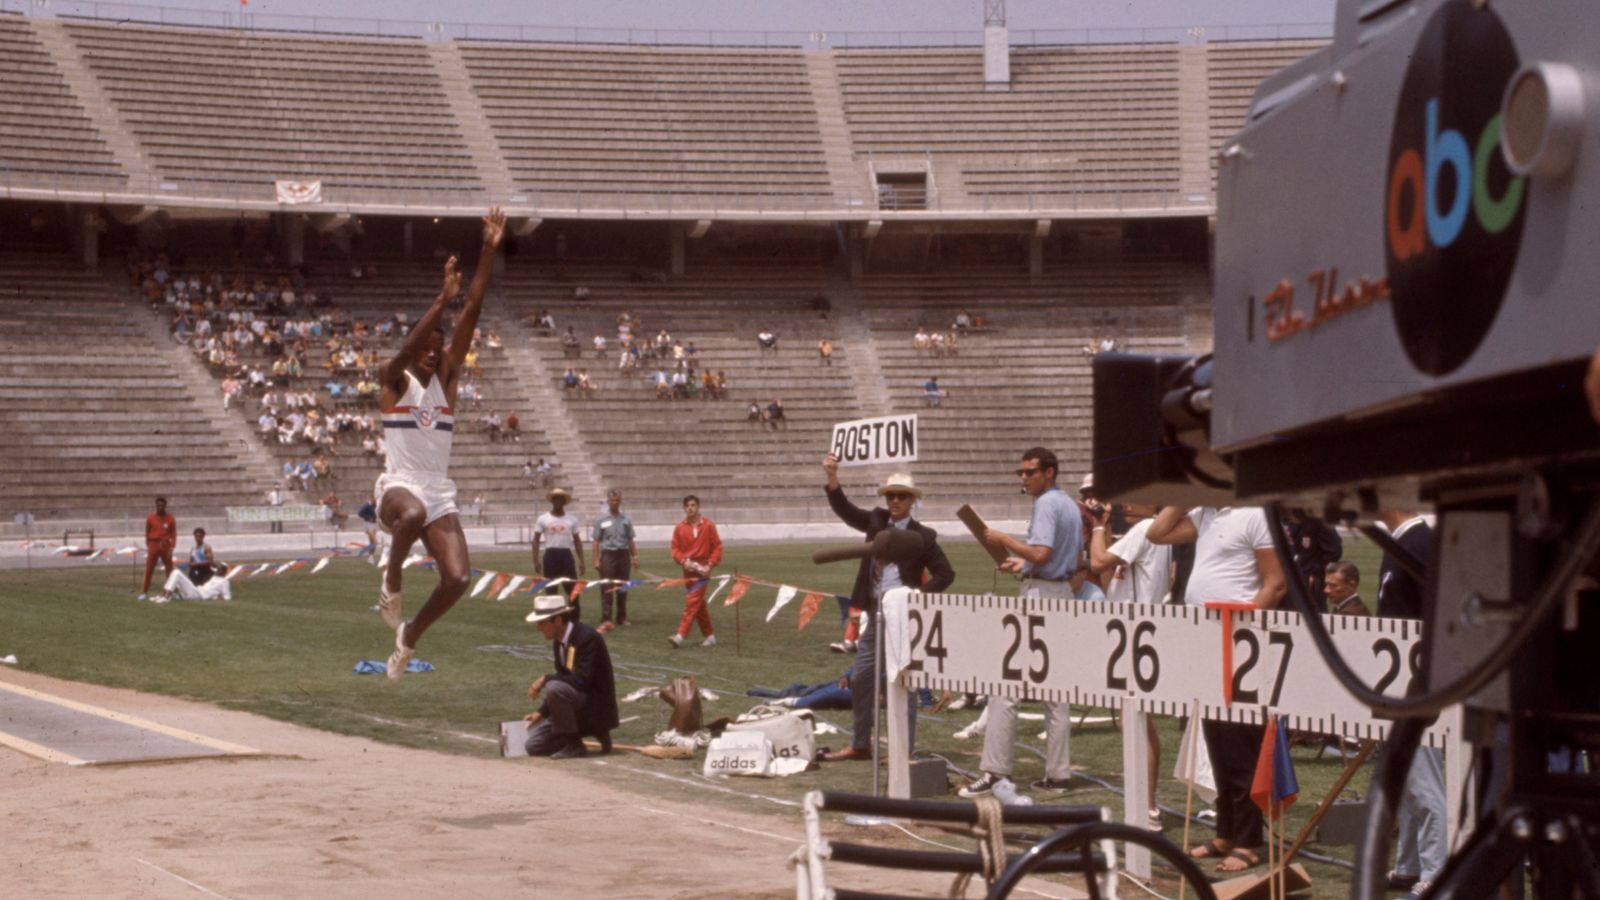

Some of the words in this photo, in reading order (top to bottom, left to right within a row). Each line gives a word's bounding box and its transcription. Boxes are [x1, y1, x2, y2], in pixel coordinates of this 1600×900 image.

[1387, 97, 1525, 261] abc
[833, 418, 914, 463] BOSTON
[908, 609, 948, 674] 24
[1002, 614, 1050, 684] 25
[1105, 618, 1160, 693] 26
[1232, 628, 1294, 707] 27
[711, 755, 757, 769] adidas
